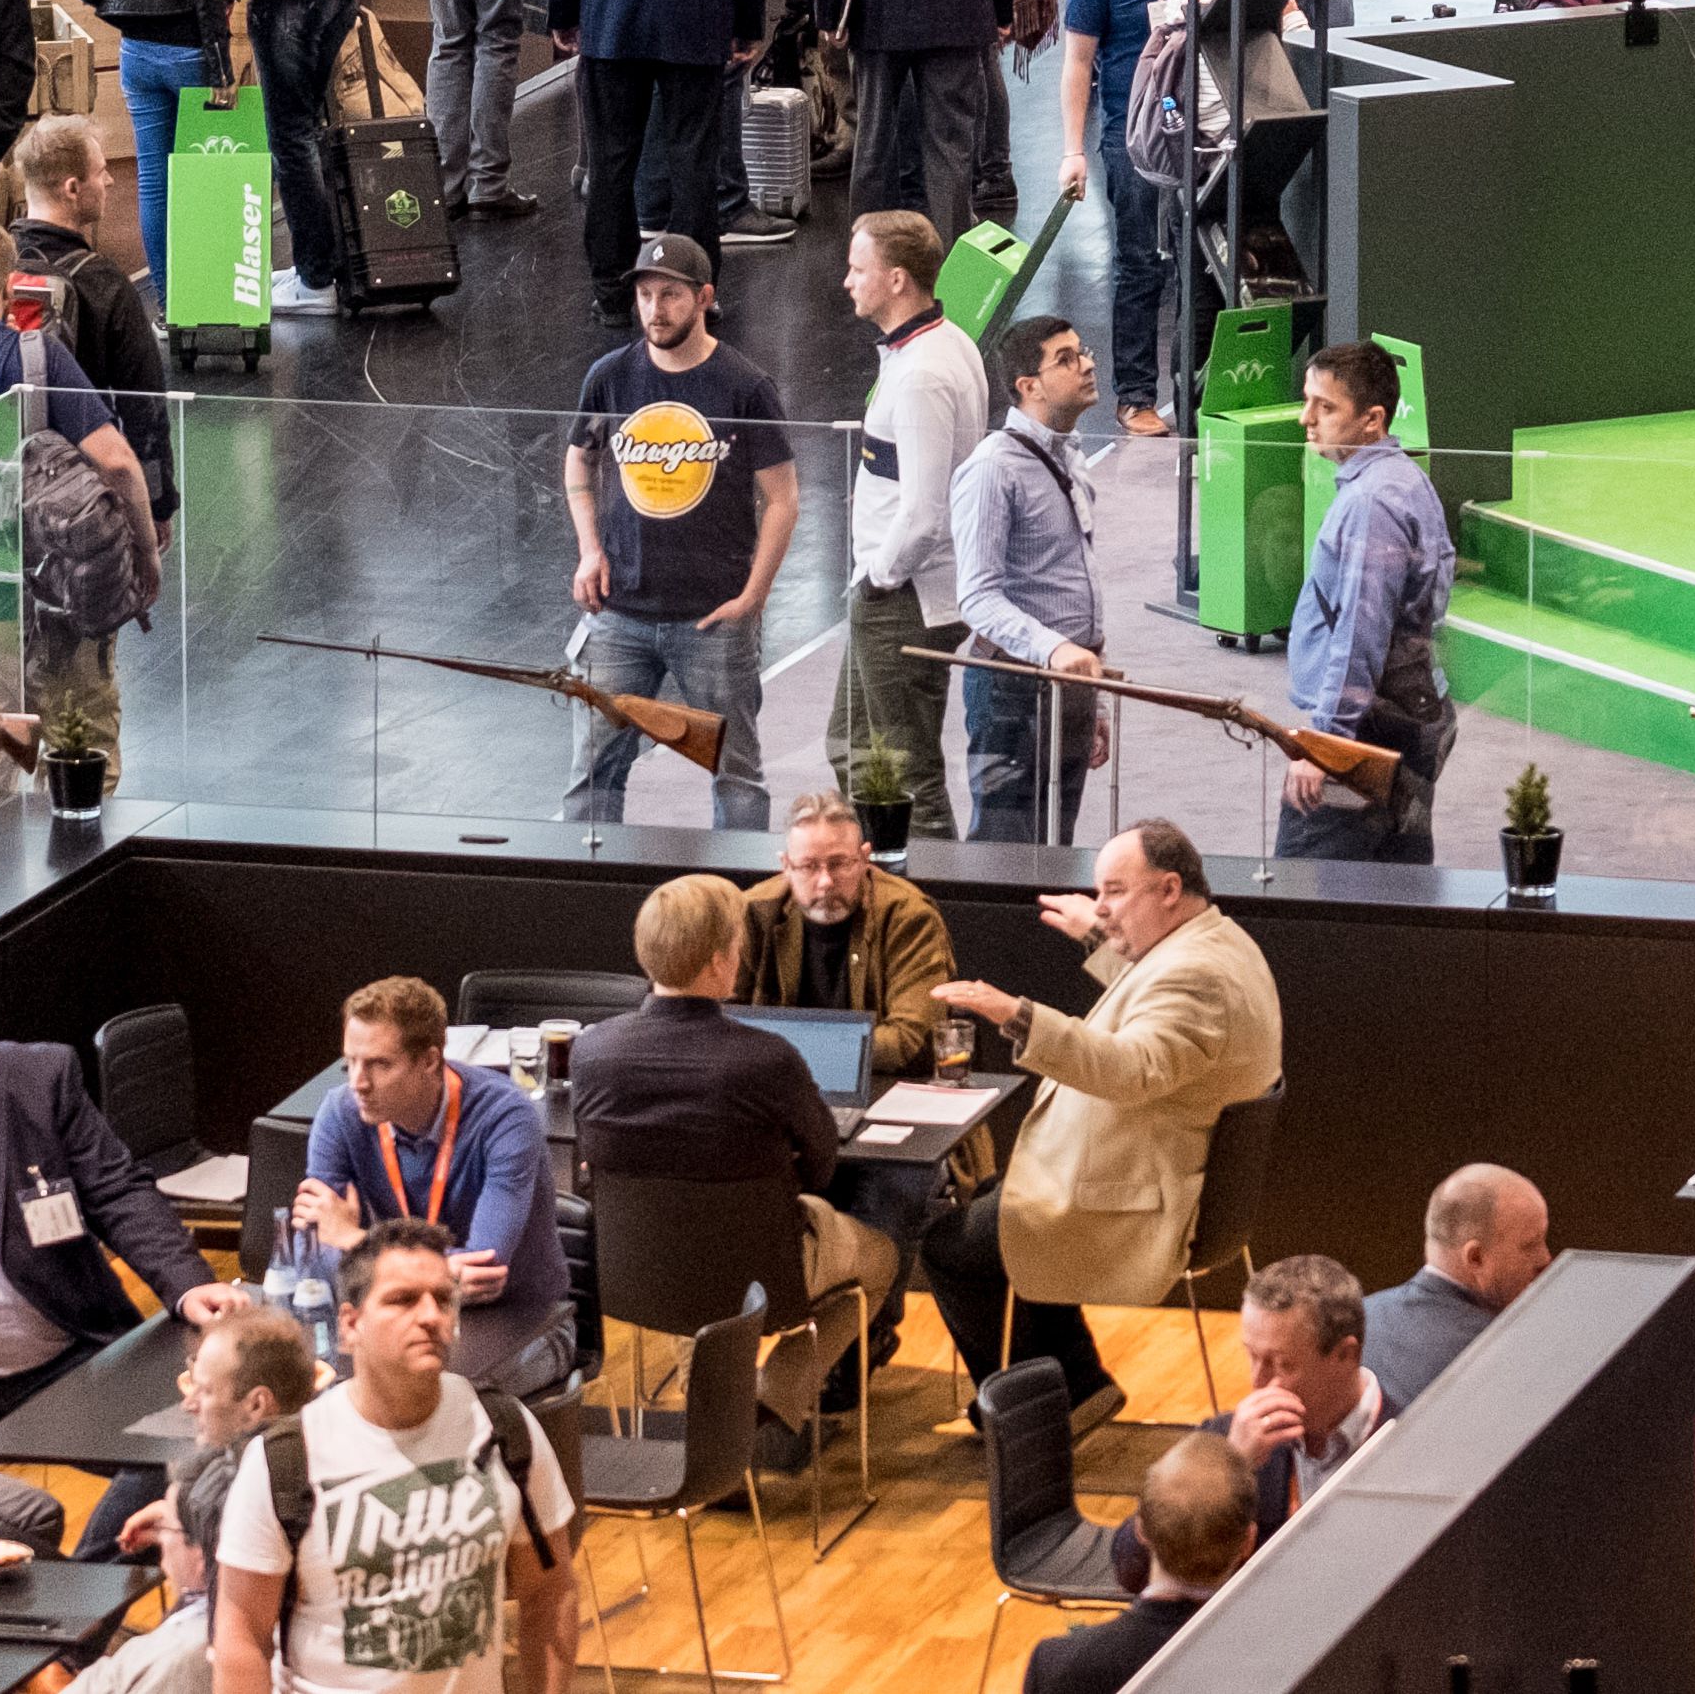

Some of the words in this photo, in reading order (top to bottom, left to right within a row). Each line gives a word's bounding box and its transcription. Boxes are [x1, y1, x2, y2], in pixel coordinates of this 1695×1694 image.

[233, 183, 262, 308] Blaser
[610, 432, 730, 474] Clawgear
[318, 1474, 496, 1566] True
[337, 1531, 504, 1617] Religion
